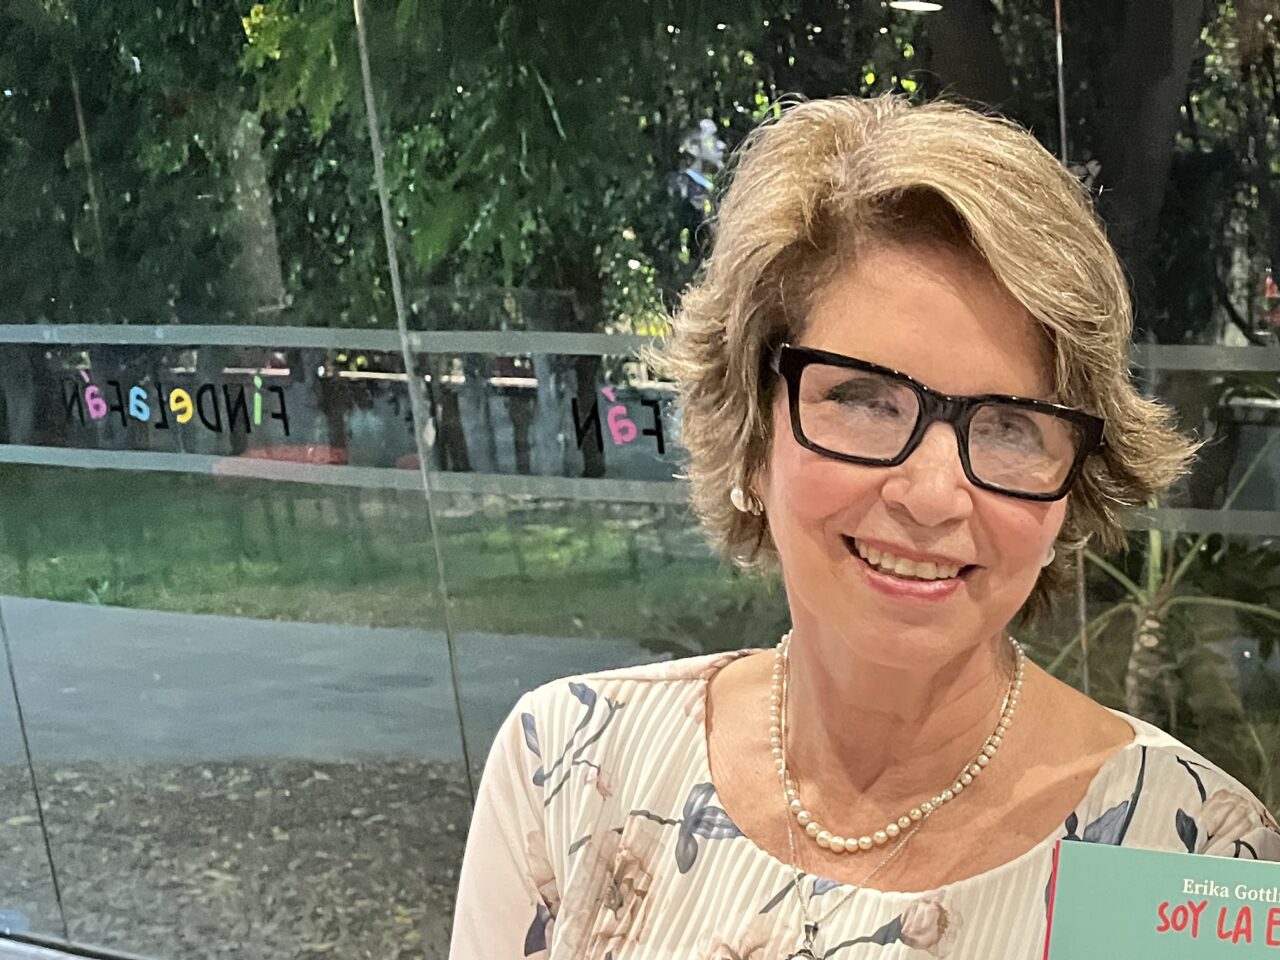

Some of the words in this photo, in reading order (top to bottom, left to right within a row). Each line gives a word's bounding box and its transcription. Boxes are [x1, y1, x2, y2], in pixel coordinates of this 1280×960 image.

[1182, 878, 1230, 898] Erika
[1156, 900, 1208, 938] SOY
[1217, 906, 1252, 944] LA
